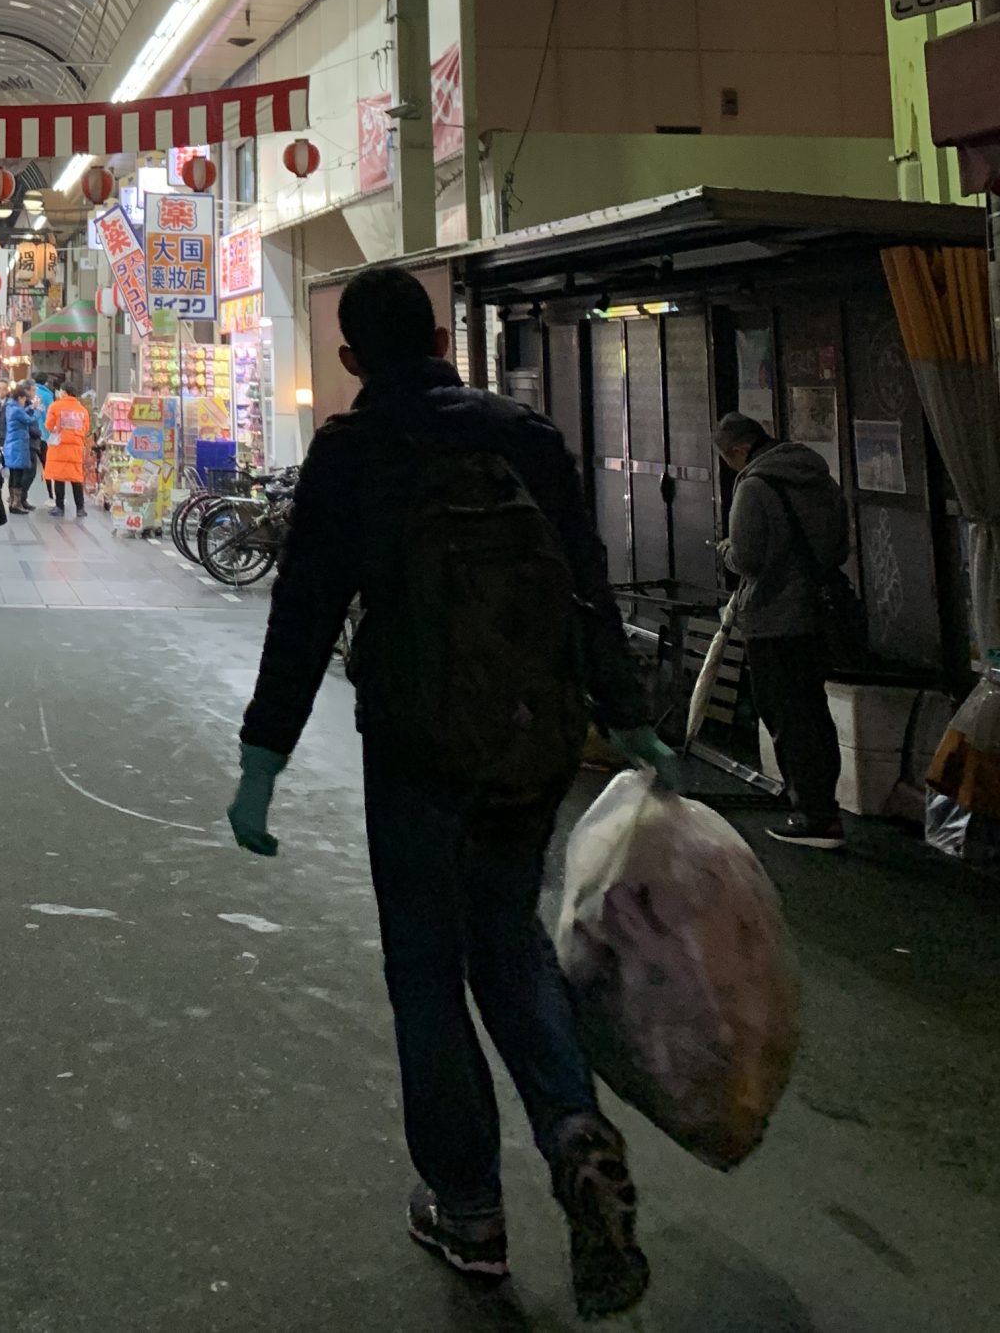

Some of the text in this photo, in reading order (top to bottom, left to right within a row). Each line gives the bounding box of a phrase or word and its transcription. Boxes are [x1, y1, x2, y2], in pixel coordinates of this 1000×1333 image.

[160, 197, 196, 230] 薬
[153, 237, 204, 263] 大国
[153, 297, 206, 314] ダイコク
